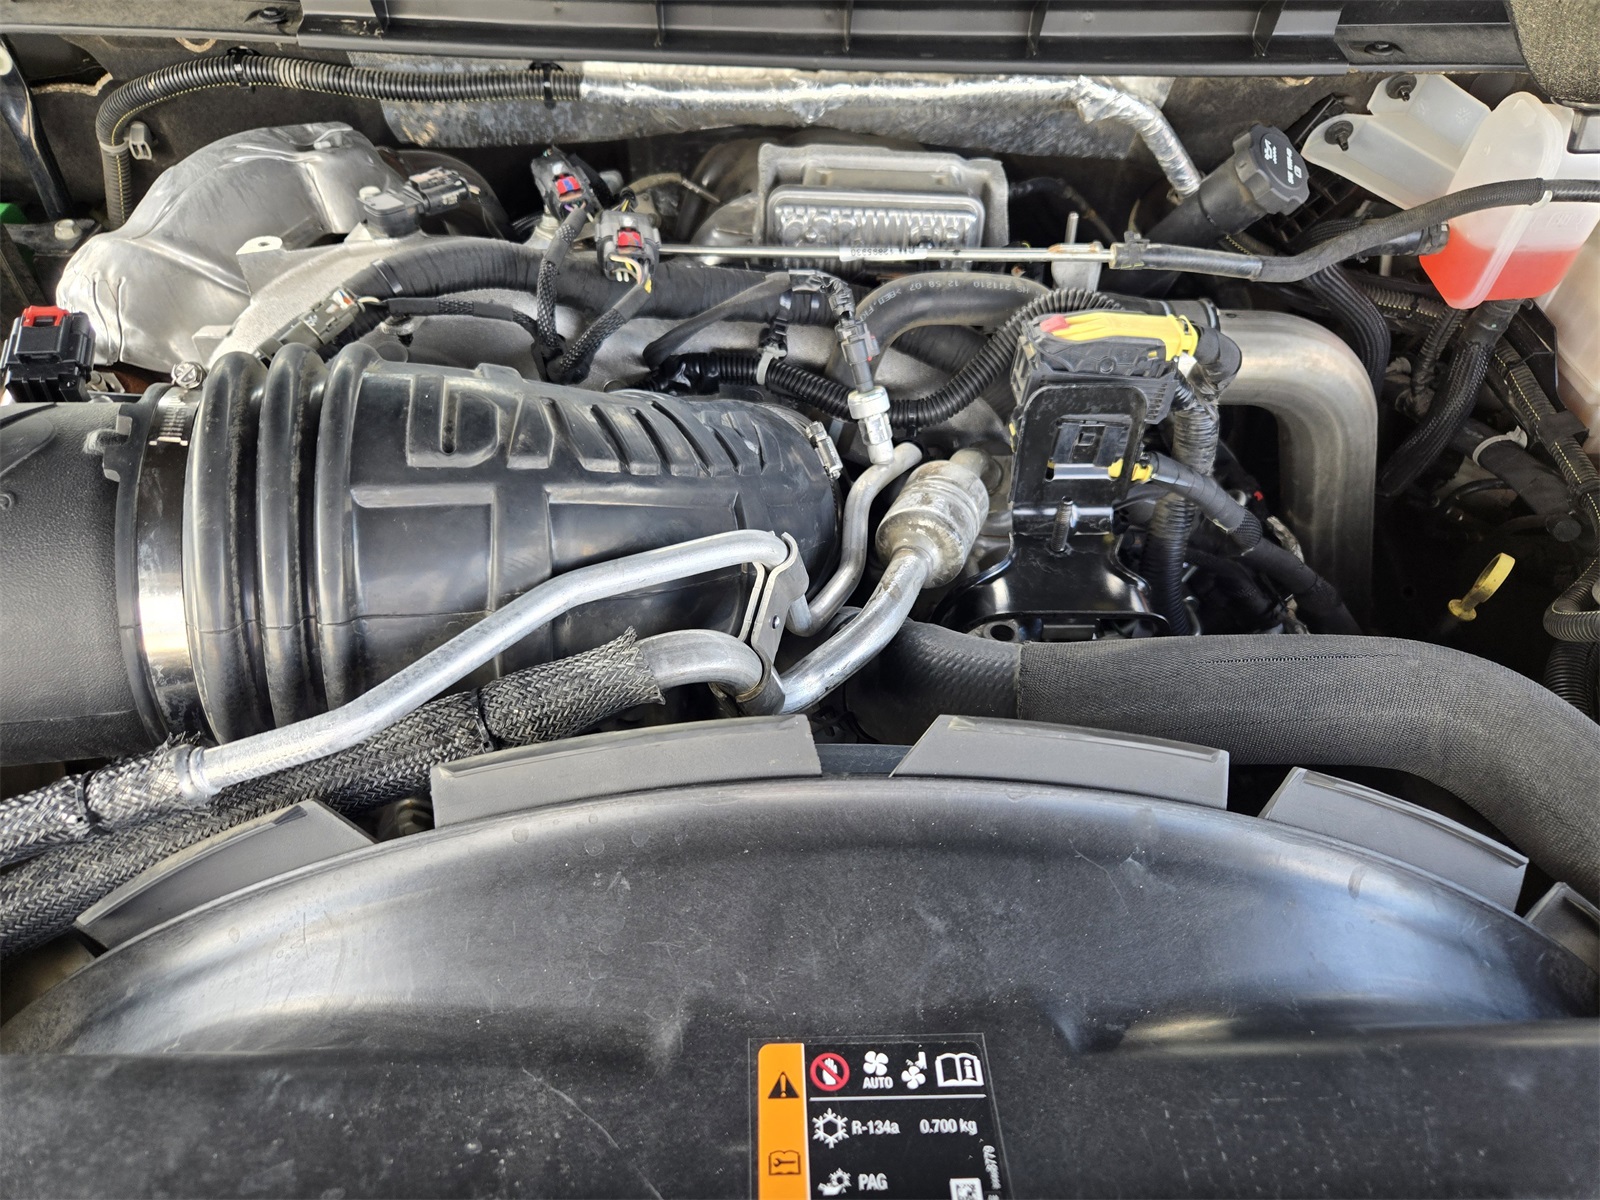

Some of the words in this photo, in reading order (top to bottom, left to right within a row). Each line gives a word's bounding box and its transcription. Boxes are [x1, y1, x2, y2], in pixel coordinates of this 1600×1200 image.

[862, 1076, 893, 1090] AUTO
[851, 1120, 901, 1136] R-134a
[919, 1119, 957, 1134] 0.700
[958, 1118, 978, 1136] kg
[857, 1173, 889, 1191] PAG
